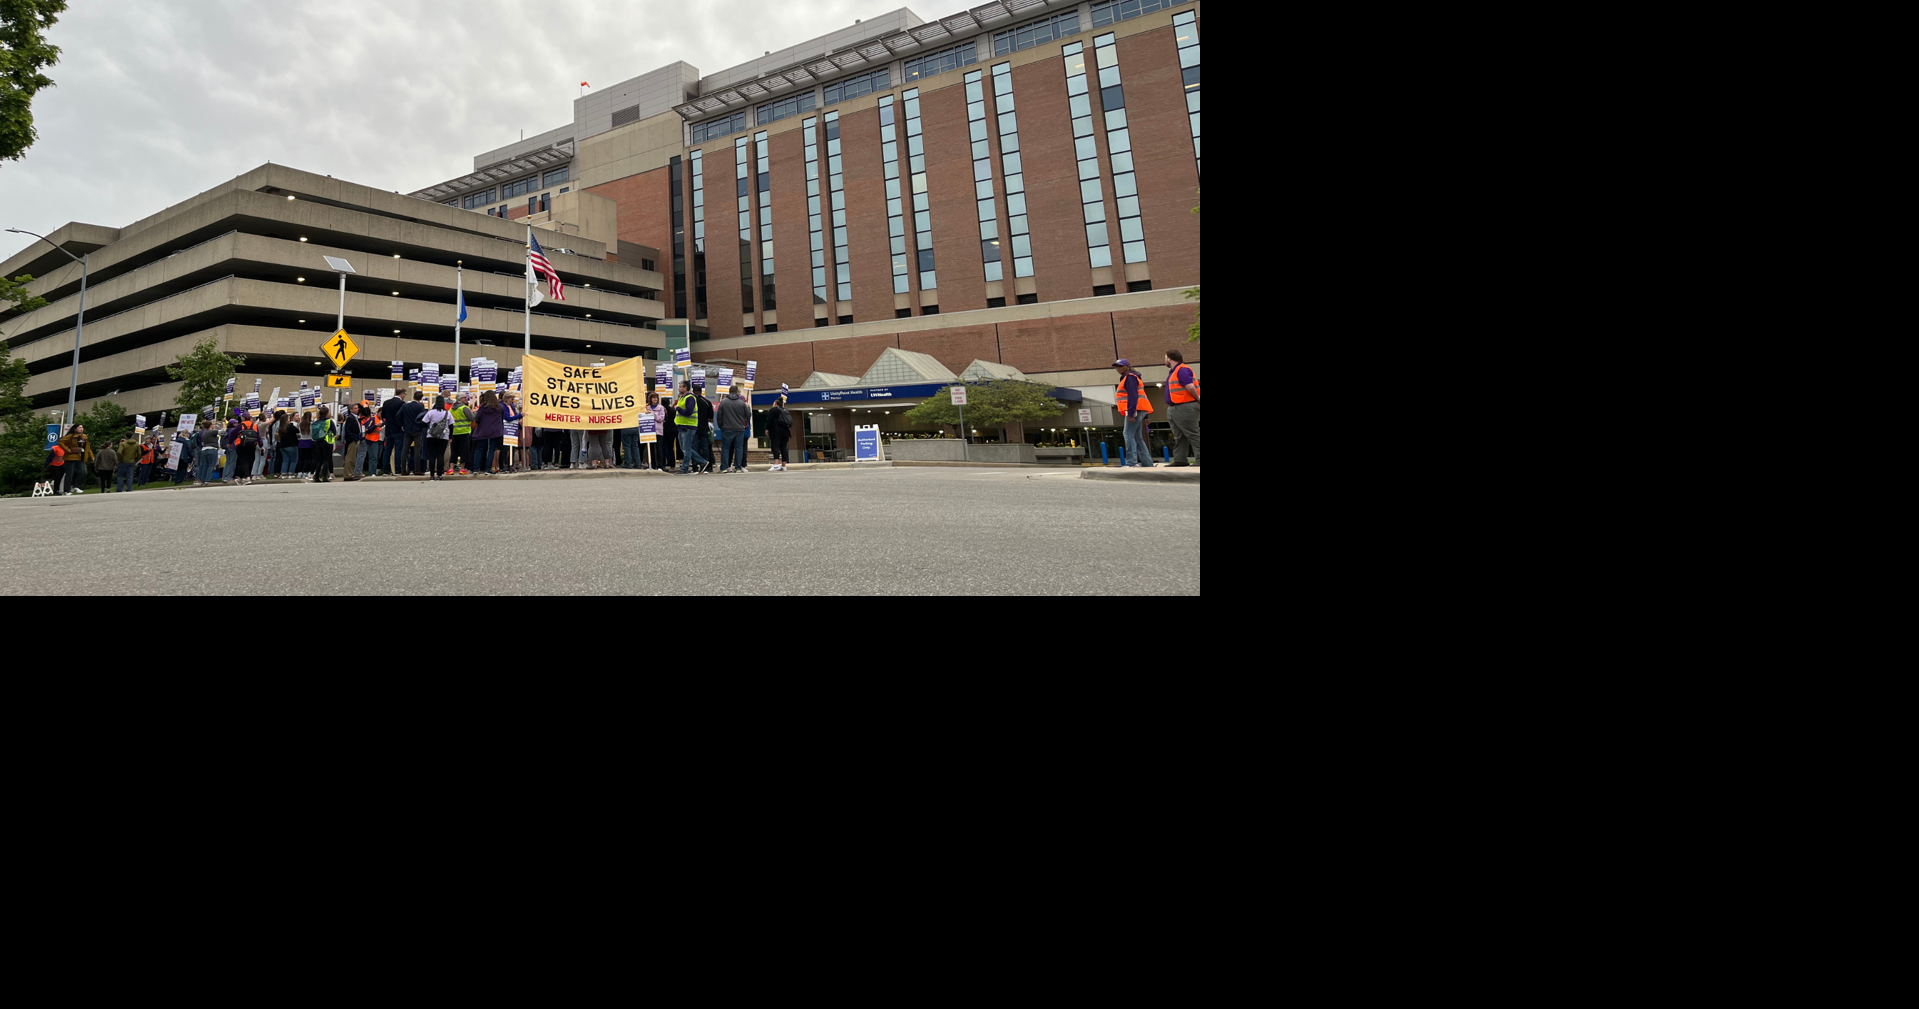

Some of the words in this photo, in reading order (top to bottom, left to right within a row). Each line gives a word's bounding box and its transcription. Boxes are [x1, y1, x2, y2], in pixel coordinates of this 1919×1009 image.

[563, 366, 602, 379] SAFE
[547, 377, 619, 395] STAFFING
[530, 392, 581, 409] SAVES
[591, 395, 635, 410] LIVES
[545, 413, 581, 423] MERITER
[588, 415, 623, 424] NURSES
